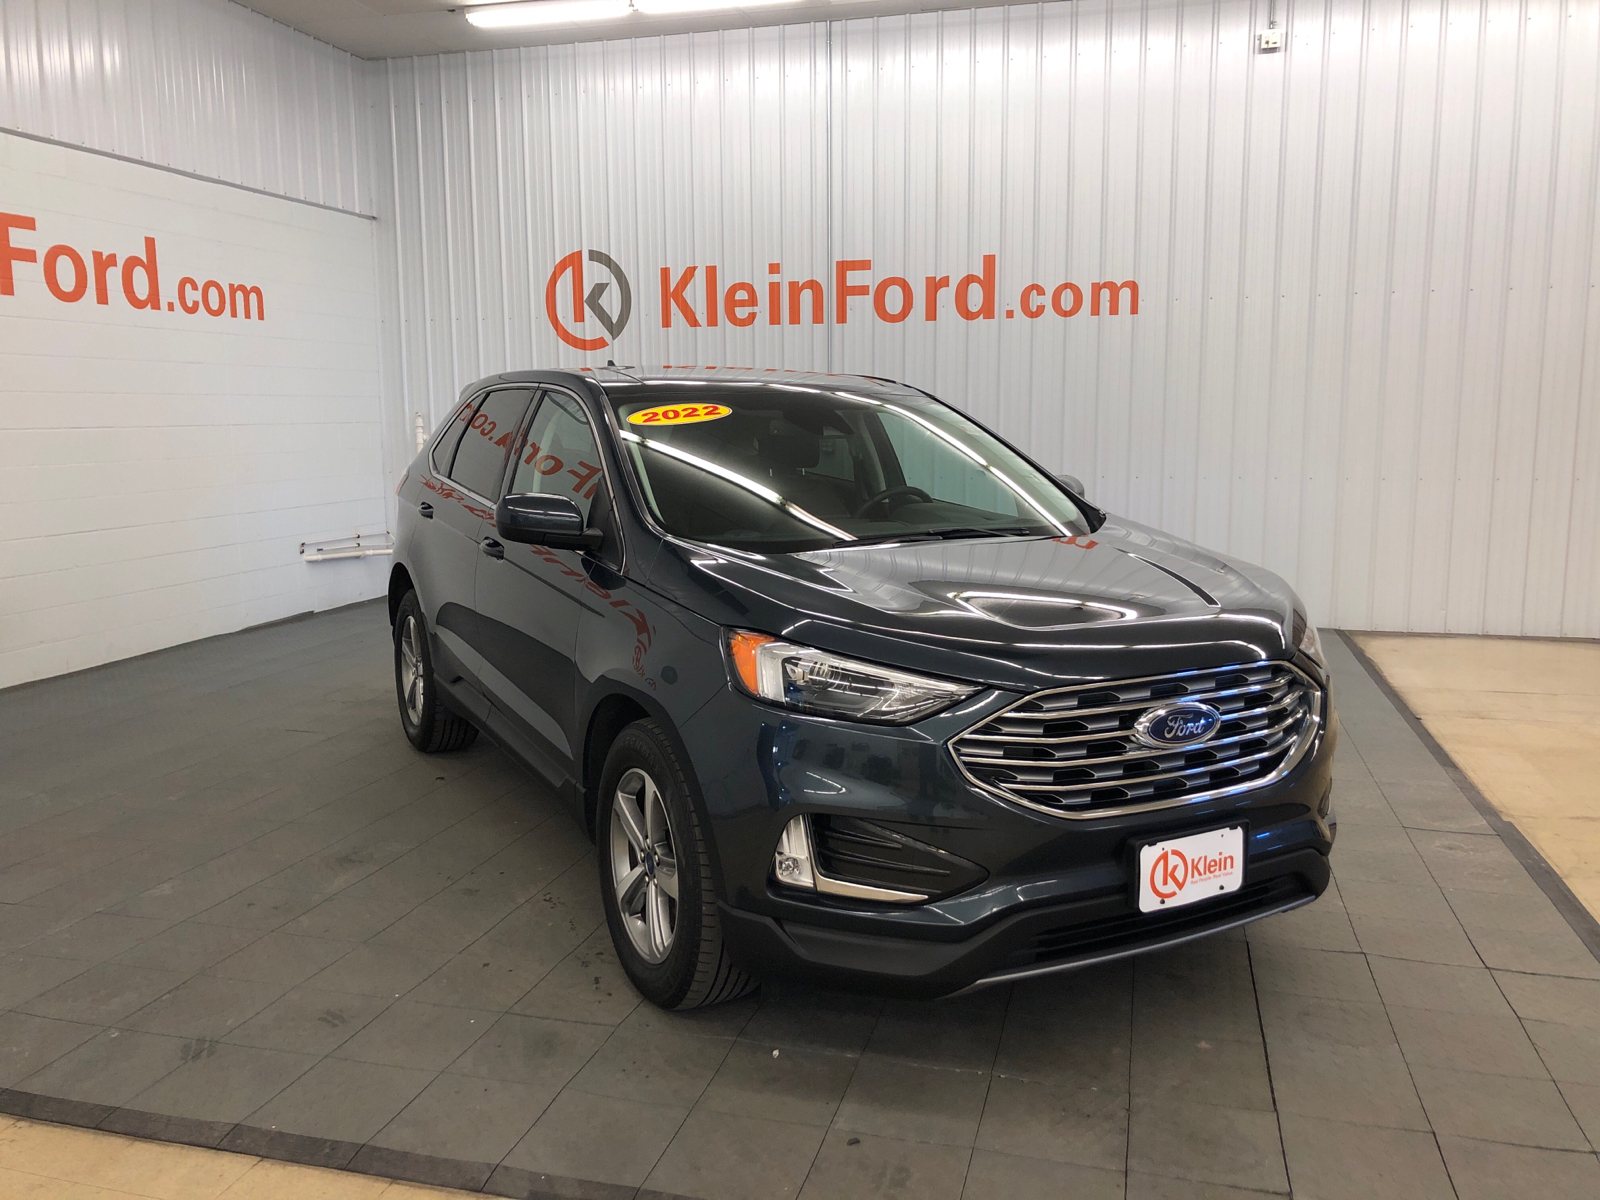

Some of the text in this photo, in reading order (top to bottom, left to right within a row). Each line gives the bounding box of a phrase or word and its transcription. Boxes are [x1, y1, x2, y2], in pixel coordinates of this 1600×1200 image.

[0, 212, 265, 321] Ford.com
[660, 254, 1139, 328] KleinFord.com
[641, 405, 722, 423] 2022
[1164, 713, 1205, 738] Ford
[1190, 852, 1234, 879] Klein
